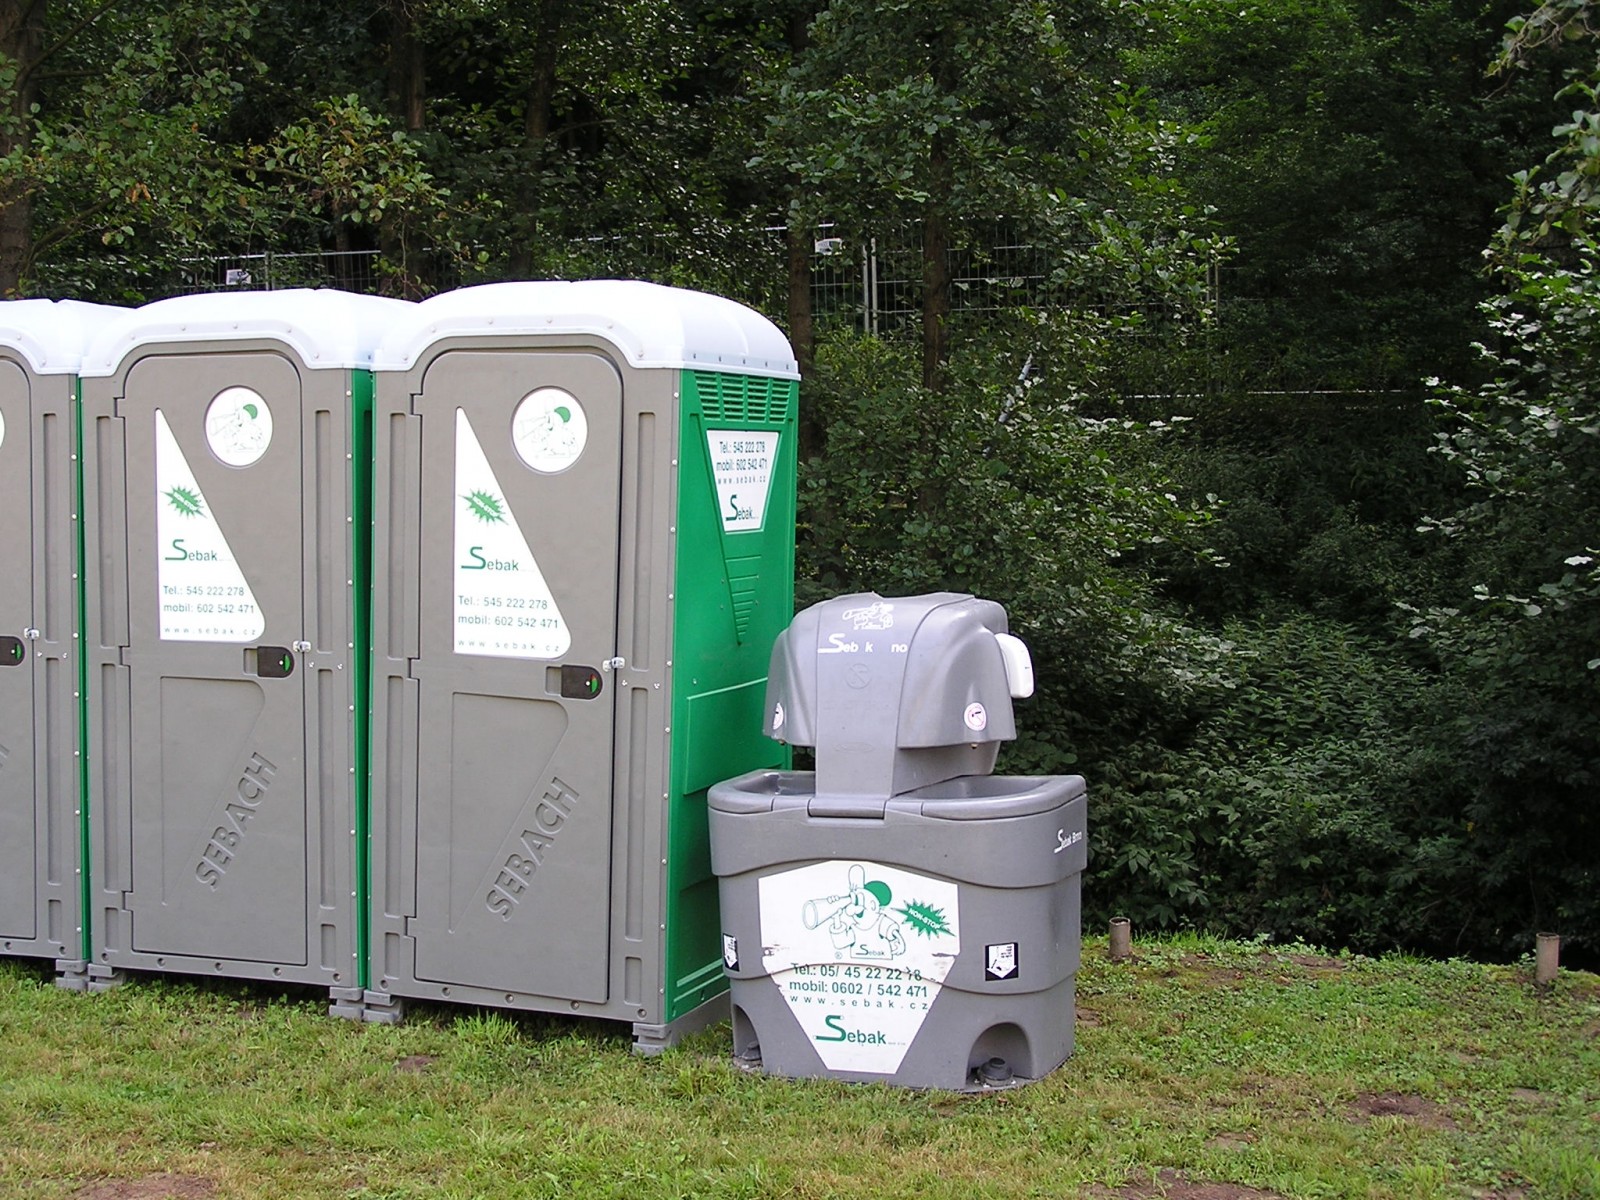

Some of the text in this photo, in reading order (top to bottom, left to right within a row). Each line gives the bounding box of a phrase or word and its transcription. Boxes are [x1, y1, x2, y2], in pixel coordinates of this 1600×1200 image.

[733, 441, 744, 453] 545
[745, 441, 755, 453] 222
[756, 441, 766, 453] 278
[736, 459, 746, 471] 602
[748, 458, 758, 470] 542
[759, 458, 768, 469] 471
[725, 494, 753, 521] Sebak
[165, 539, 218, 561] Sebak
[461, 546, 519, 571] Sebak
[163, 585, 245, 596] Tel.: 545 222 278
[163, 603, 254, 613] mobil: 602 542 471
[483, 597, 502, 607] 545
[506, 598, 525, 608] 222
[529, 599, 548, 610] 278
[458, 615, 558, 628] mobil: 602 542 471
[195, 752, 277, 892] SEBACH
[486, 776, 579, 922] SEBACH
[908, 908, 941, 929] NON-STOP
[790, 962, 816, 976] Tel.:
[820, 965, 839, 977] 05/
[844, 966, 861, 978] 45
[865, 967, 881, 979] 22
[886, 968, 902, 980] 22
[789, 980, 928, 998] mobil: 0602 / 542 471
[815, 1014, 886, 1045] Sebak
